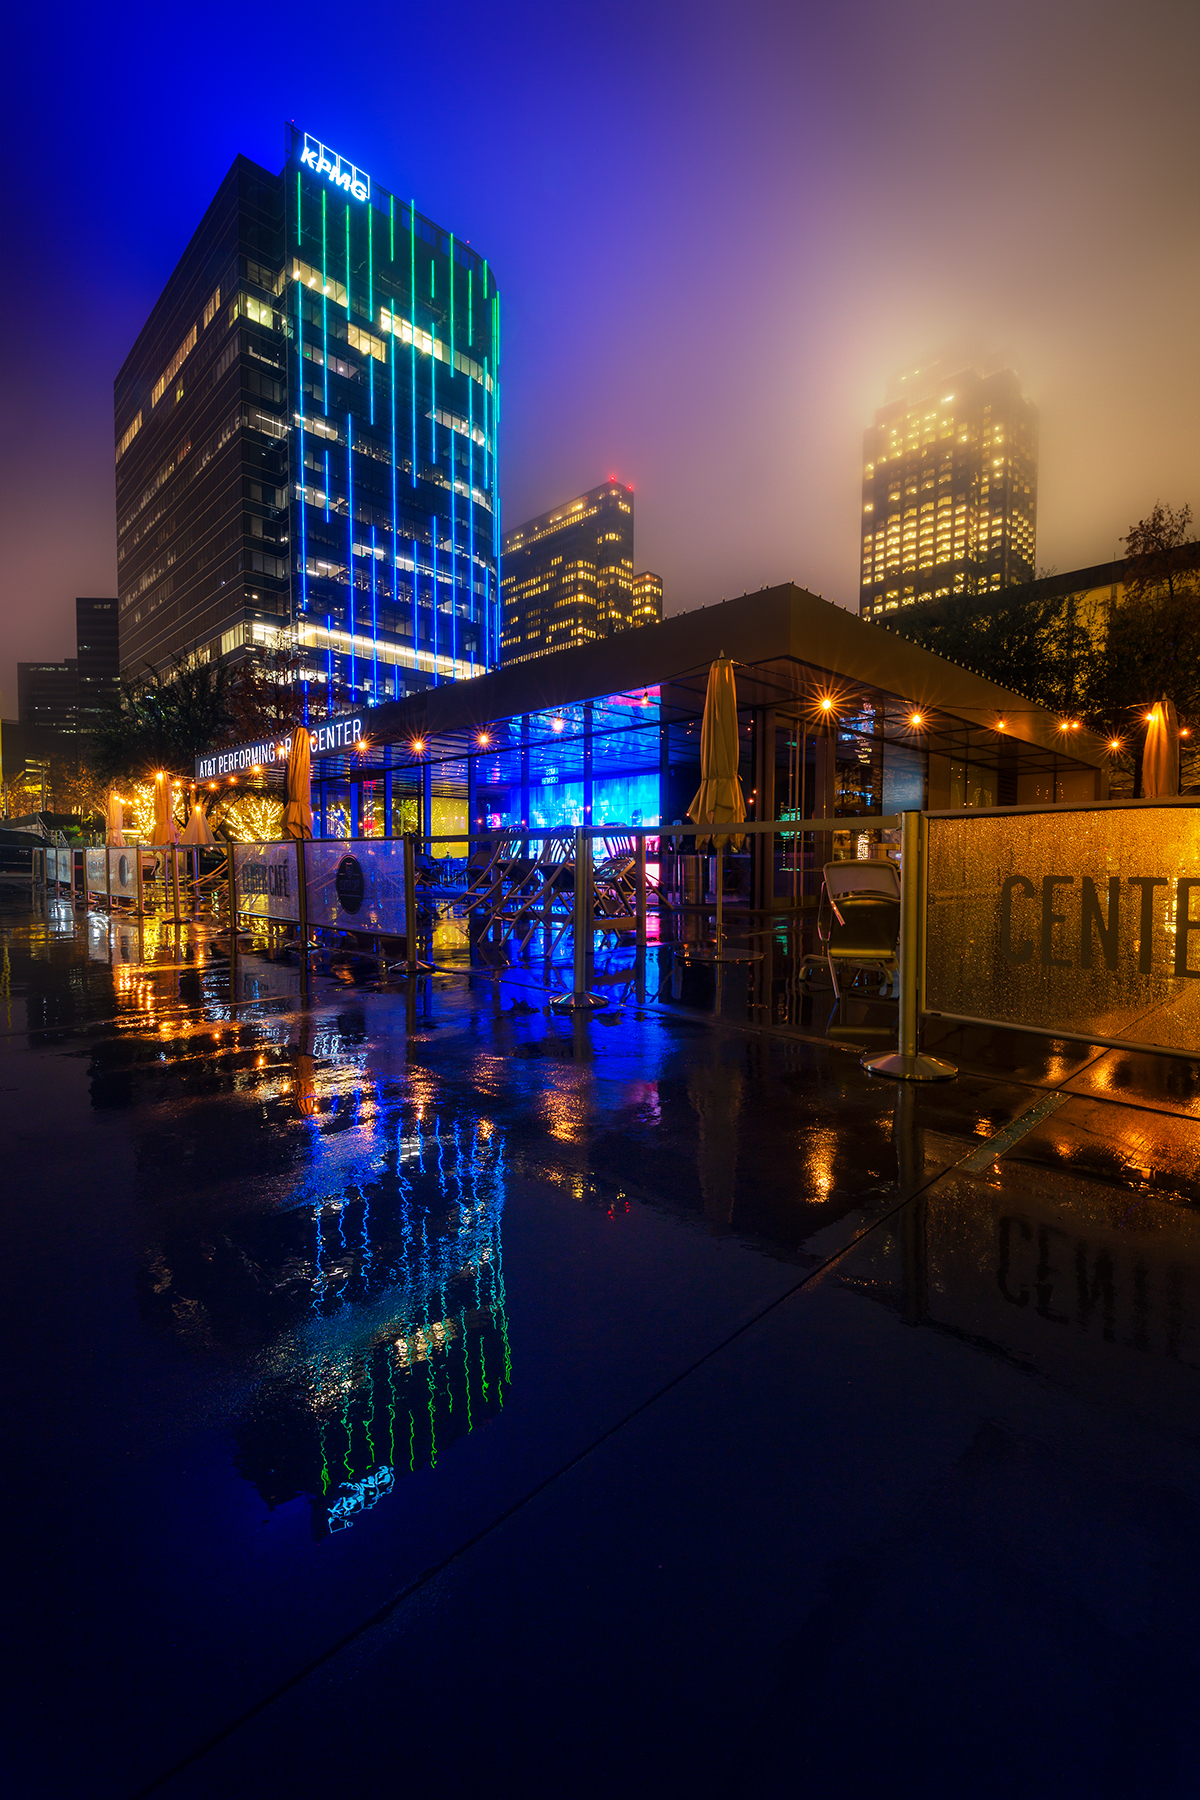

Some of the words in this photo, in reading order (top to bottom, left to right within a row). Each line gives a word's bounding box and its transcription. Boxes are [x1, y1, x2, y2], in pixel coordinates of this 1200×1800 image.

[301, 145, 368, 202] KPMG
[199, 757, 217, 778] AT&T
[218, 742, 276, 773] PERFORMING
[310, 718, 362, 753] CENTER
[268, 858, 290, 898] CAFÉ
